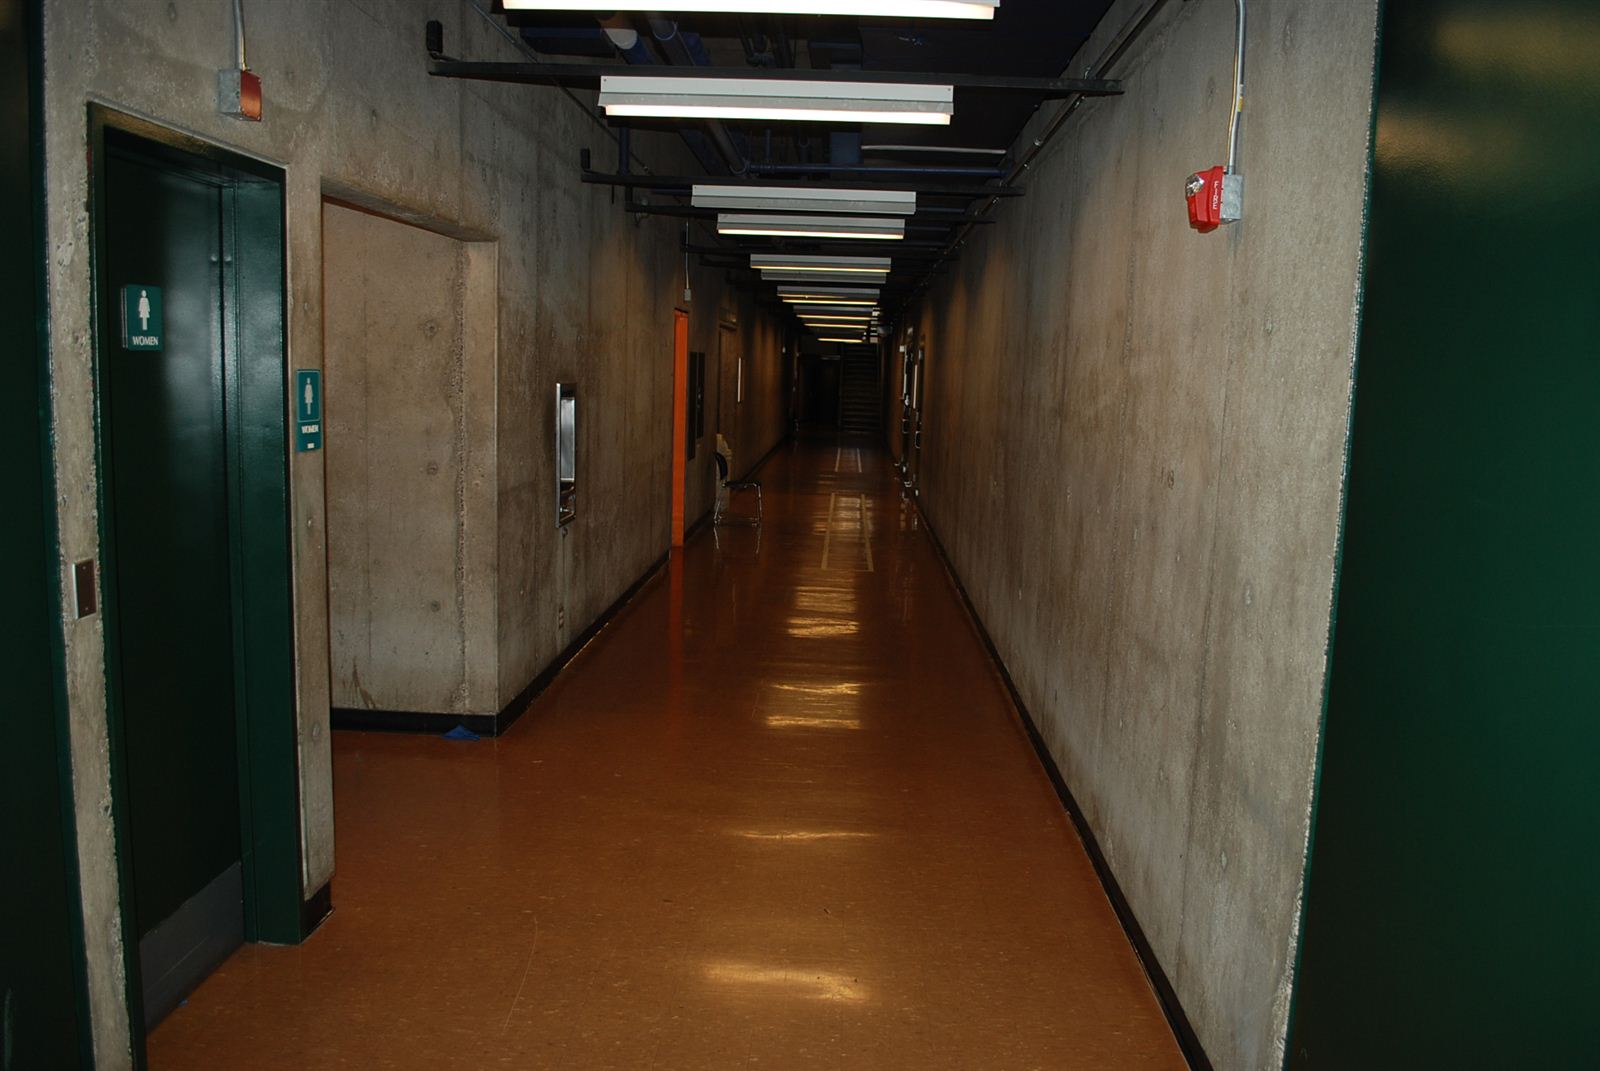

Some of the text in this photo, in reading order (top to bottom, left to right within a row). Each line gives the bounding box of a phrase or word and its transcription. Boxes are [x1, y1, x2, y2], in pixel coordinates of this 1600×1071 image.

[1212, 180, 1220, 210] FIRE
[132, 335, 159, 346] WOMEN
[301, 424, 319, 434] WOMEN
